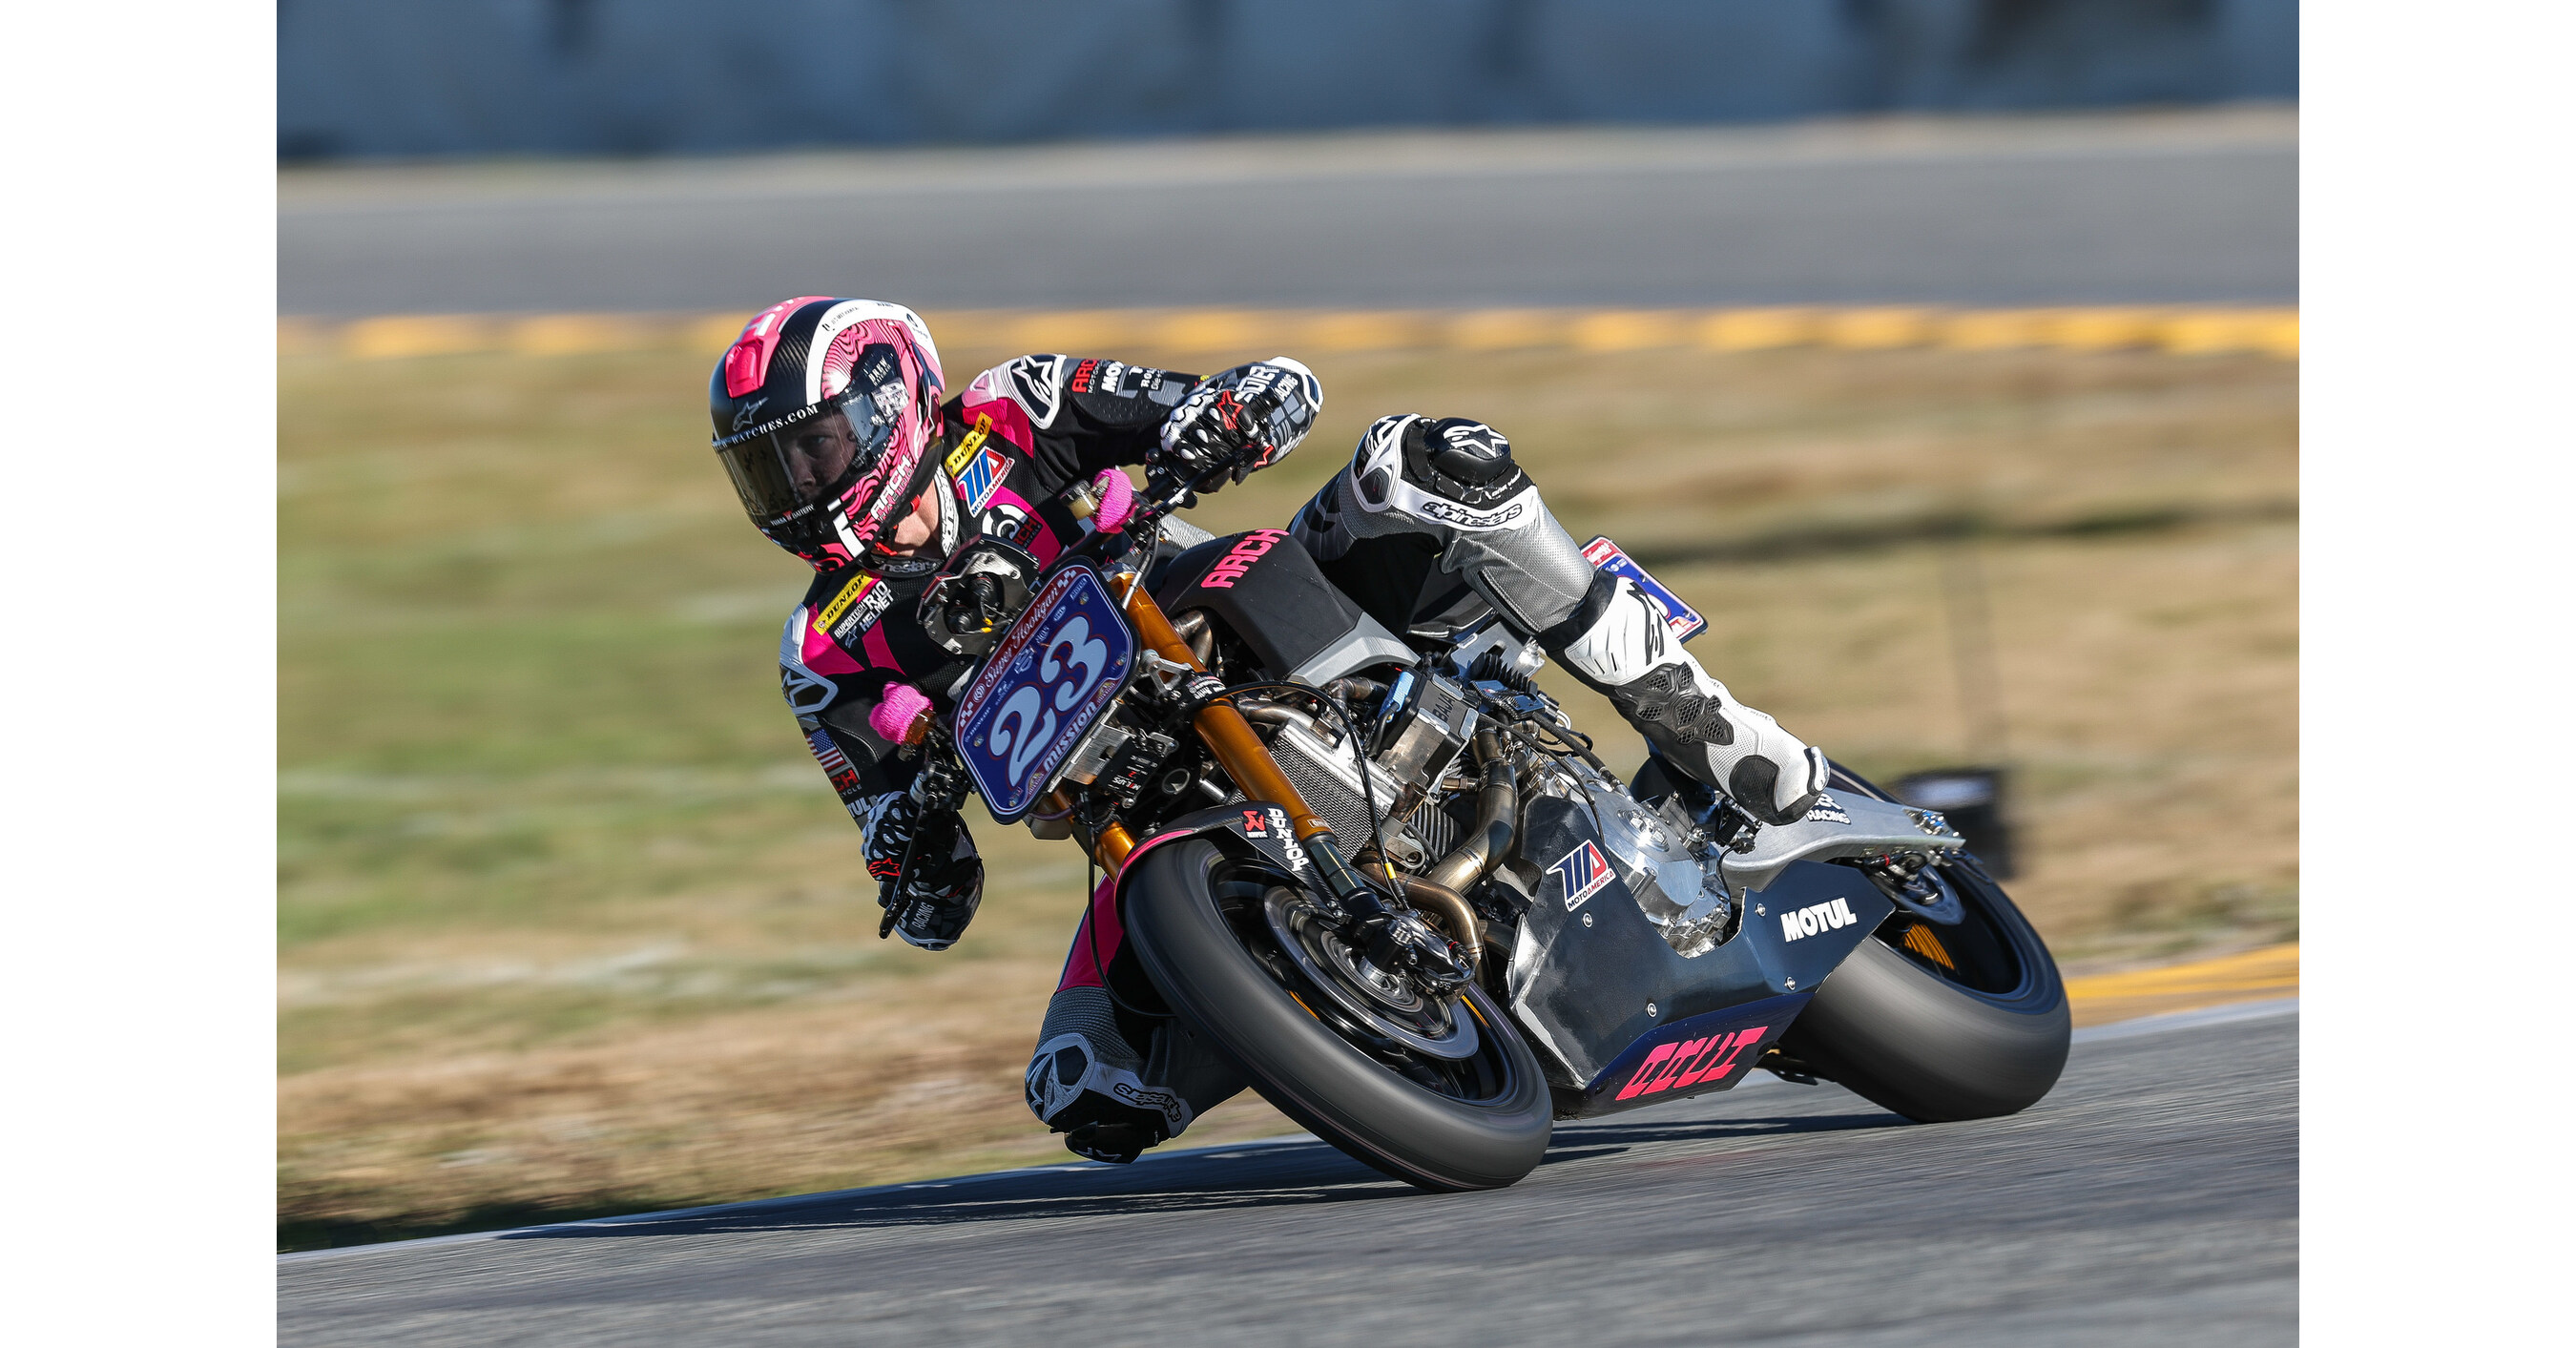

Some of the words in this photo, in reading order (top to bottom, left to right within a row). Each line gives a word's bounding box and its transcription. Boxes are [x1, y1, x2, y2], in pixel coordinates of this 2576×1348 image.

[1071, 359, 1098, 393] ARC
[1275, 374, 1298, 402] ACING
[731, 404, 819, 445] WATCHES.COM
[954, 419, 987, 465] DUNLOP
[870, 454, 912, 520] ARCH
[971, 459, 1013, 515] MOTOAMERICA
[791, 503, 814, 519] BATTERY
[1013, 518, 1037, 546] RCH
[1423, 502, 1523, 528] alpinestars
[1200, 529, 1290, 588] ARCH
[827, 574, 864, 619] DUNLOP
[834, 601, 866, 637] SUPERTECH
[862, 580, 888, 610] R10
[860, 589, 893, 632] HELMET
[985, 645, 1013, 687] Super
[1011, 587, 1058, 649] Hooligan
[990, 615, 1108, 787] 23
[1433, 693, 1456, 722] BAJA
[1043, 701, 1096, 772] mission
[831, 769, 859, 791] CH
[846, 798, 871, 818] TUL
[1806, 809, 1851, 824] RACING
[1268, 808, 1309, 871] DUNLOP
[1568, 870, 1614, 909] MOTOAMERICA
[911, 902, 934, 930] RACING
[1780, 897, 1858, 943] MOTUL
